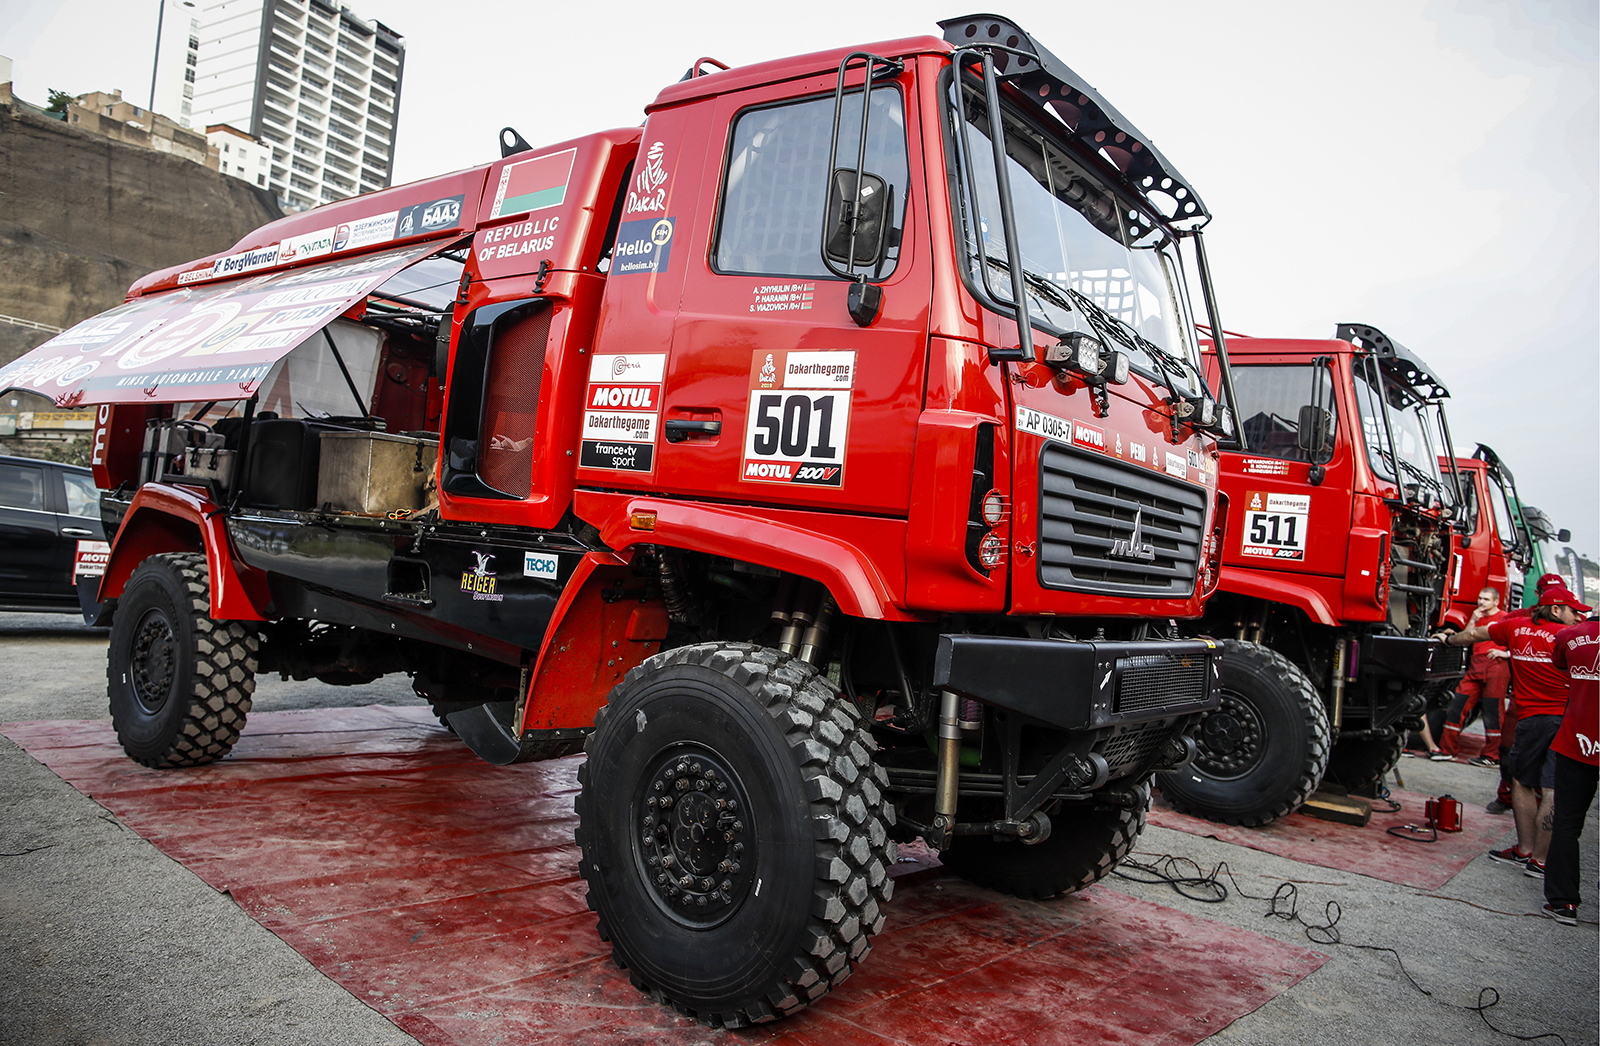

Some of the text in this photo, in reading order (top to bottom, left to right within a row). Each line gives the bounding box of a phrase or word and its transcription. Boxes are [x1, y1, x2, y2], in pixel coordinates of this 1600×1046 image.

[627, 188, 666, 214] DAKAR
[421, 202, 461, 227] БААЗ
[484, 217, 560, 244] REPUBLIC
[479, 236, 555, 262] OF BELARUS
[615, 240, 653, 258] Hello
[223, 250, 277, 272] BorgWarner
[620, 260, 659, 273] hellosim.by
[184, 269, 212, 282] BELSHINA
[115, 365, 269, 387] MINSK AUTOMOBILE PLANT
[788, 363, 850, 376] Dakarthegame
[833, 374, 849, 382] .com
[592, 387, 652, 407] MOTUL
[589, 415, 650, 431] Dakarthegame
[753, 395, 836, 459] 501
[1026, 412, 1071, 440] AP 0305-7
[633, 430, 649, 439] .com
[1075, 425, 1104, 447] MOTUL
[1130, 441, 1147, 462] PERÚ
[1188, 450, 1198, 468] 501
[612, 456, 635, 469] sport
[745, 463, 840, 480] MOTUL 300V
[1269, 499, 1307, 507] Dakarthegame
[1250, 514, 1299, 547] 511
[1244, 546, 1302, 557] MOTUL 300V
[525, 558, 556, 573] TECHO
[461, 573, 496, 594] REIGER
